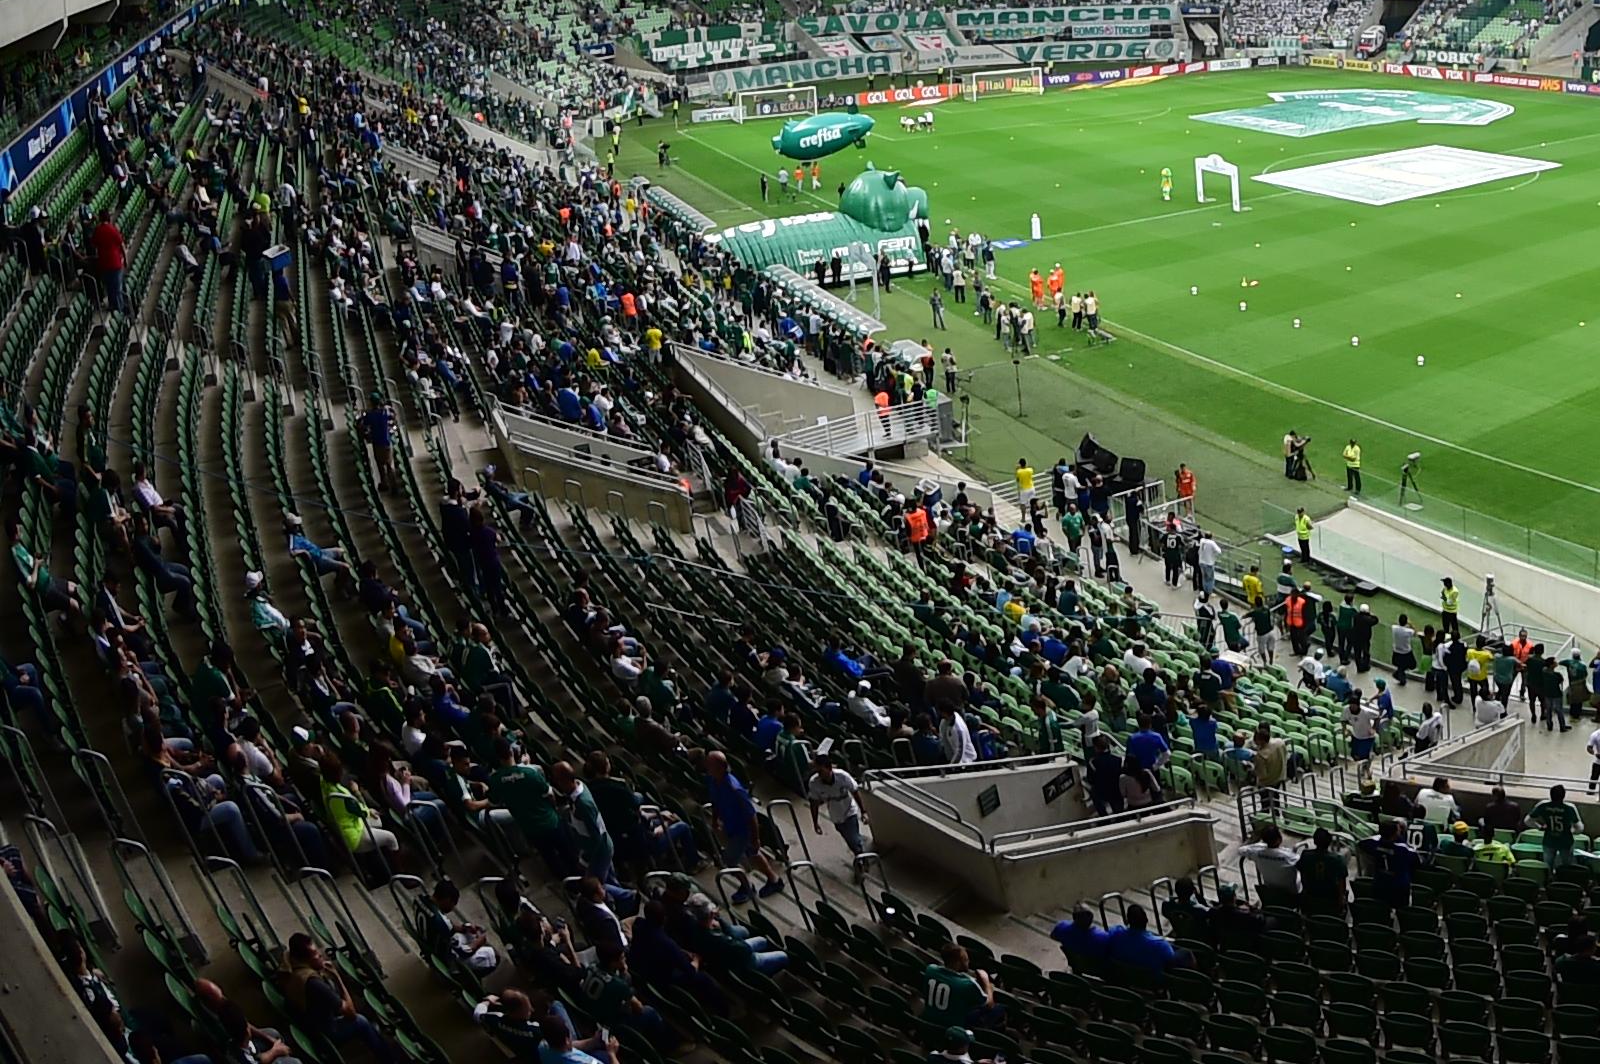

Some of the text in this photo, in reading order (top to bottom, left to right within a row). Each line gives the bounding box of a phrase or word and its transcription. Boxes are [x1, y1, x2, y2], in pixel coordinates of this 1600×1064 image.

[798, 10, 946, 35] SAVOIA
[957, 7, 1171, 26] MANCHA
[1016, 42, 1150, 62] VERDE
[733, 56, 891, 89] MANCHA
[867, 85, 941, 104] GOL GOL GOL
[800, 127, 842, 149] crefisa
[1549, 815, 1564, 833] 15
[928, 978, 951, 1011] 10
